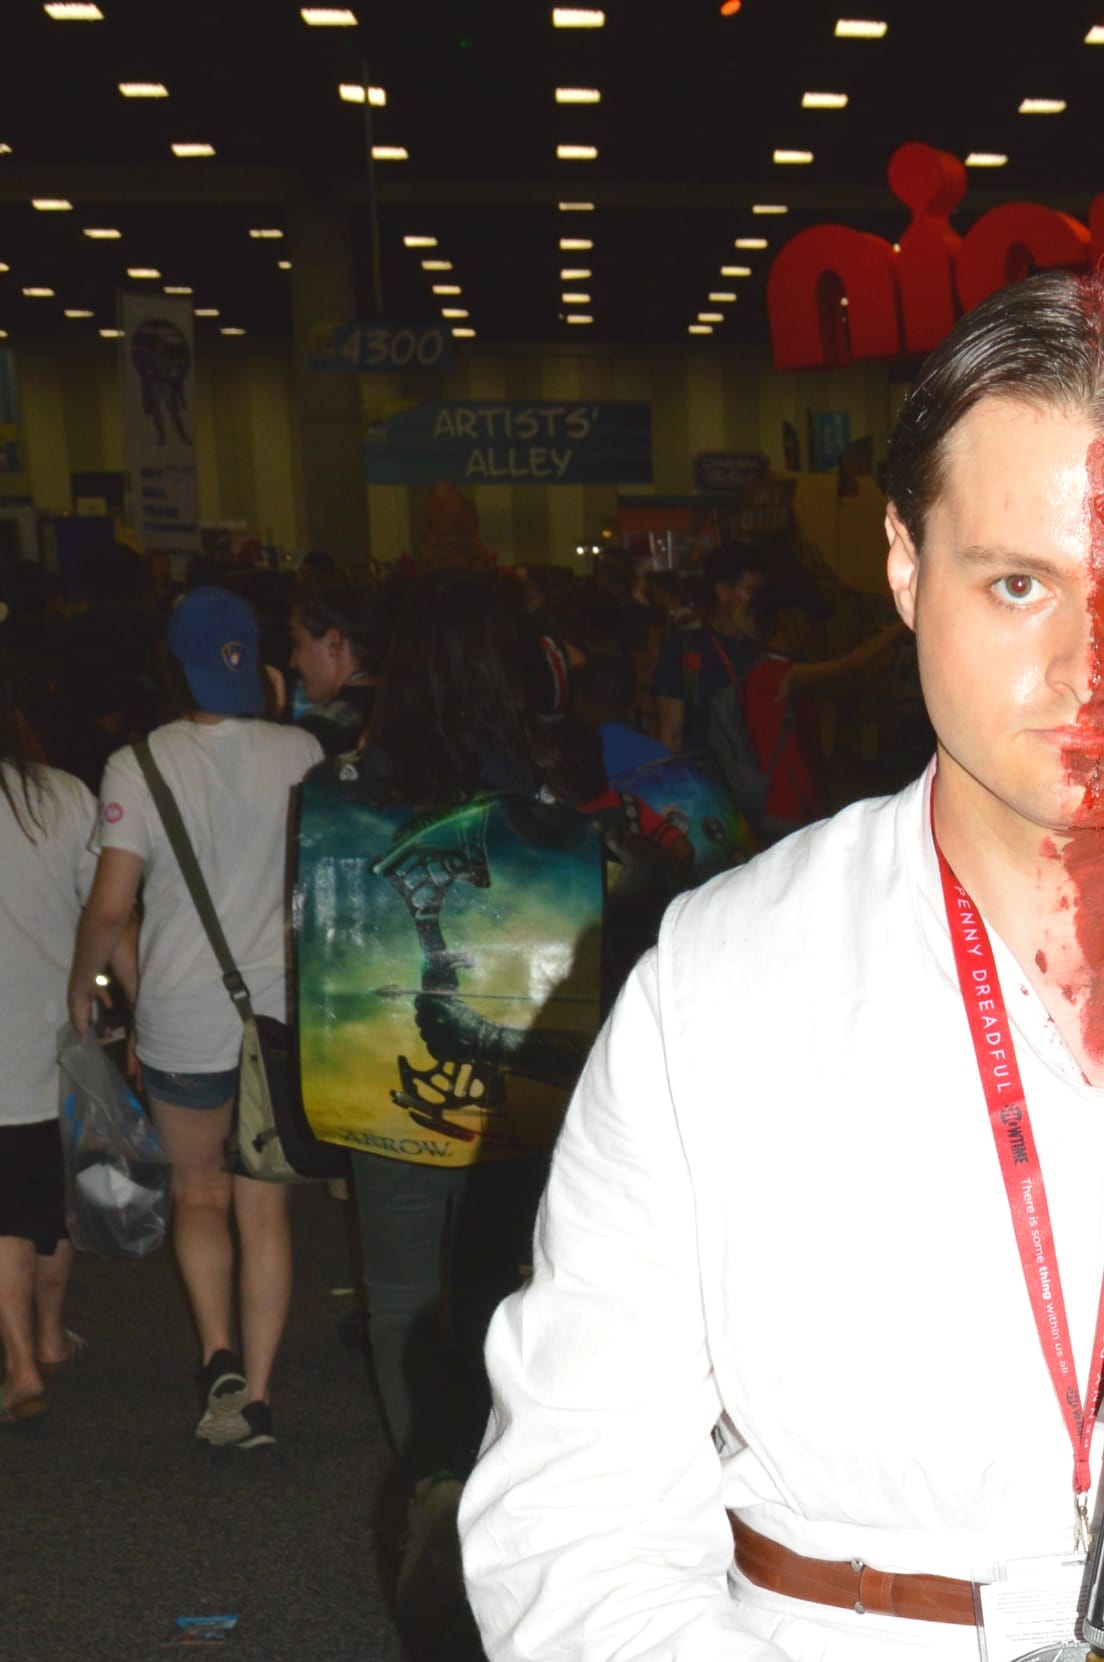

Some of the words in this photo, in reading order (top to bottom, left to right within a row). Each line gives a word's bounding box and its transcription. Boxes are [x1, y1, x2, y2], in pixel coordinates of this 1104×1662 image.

[344, 328, 444, 367] 4300
[432, 406, 600, 441] ARTISTS'
[464, 446, 574, 478] ALLEY
[953, 885, 983, 957] PENNY
[971, 968, 1013, 1095] DREADFUL
[343, 1129, 451, 1158] ARROW
[1000, 1103, 1030, 1165] SHOWTIME
[1019, 1176, 1035, 1214] There
[1028, 1214, 1038, 1228] is
[1031, 1229, 1045, 1264] some
[1038, 1265, 1052, 1301] thing
[1046, 1302, 1060, 1342] within
[1054, 1342, 1063, 1357] us
